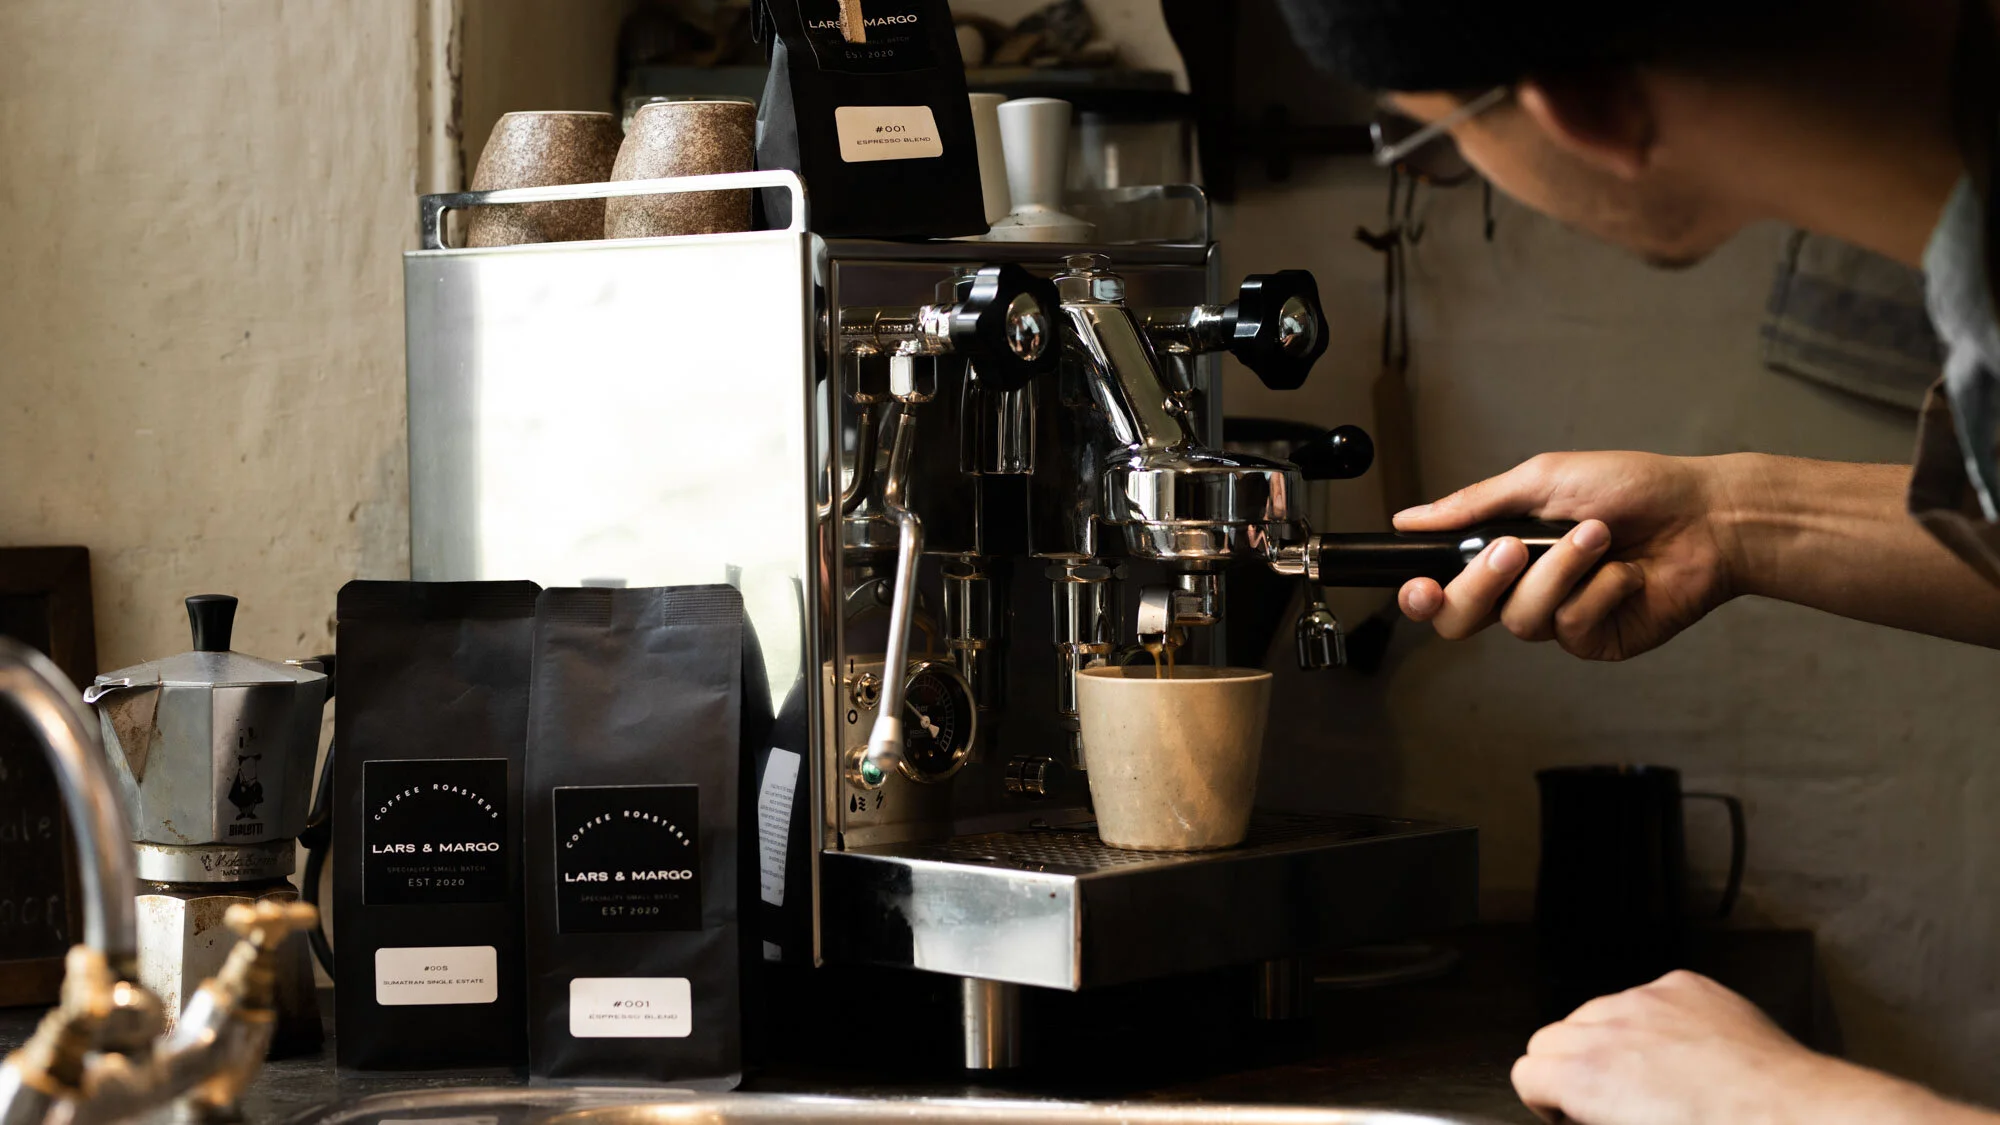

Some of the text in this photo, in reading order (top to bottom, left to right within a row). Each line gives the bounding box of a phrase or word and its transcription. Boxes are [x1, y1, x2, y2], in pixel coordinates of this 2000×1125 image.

[809, 14, 918, 29] LARS MARGO
[868, 49, 894, 58] 2020
[875, 125, 906, 133] #001
[374, 783, 498, 820] COFFEE ROASTERS
[566, 810, 690, 848] COFFEE ROASTERS
[372, 842, 500, 854] LARS & MARGO
[564, 869, 693, 882] LARS & MARGO
[408, 878, 465, 887] EST 2020
[601, 906, 659, 916] EST 2020
[613, 1000, 650, 1008] #001
